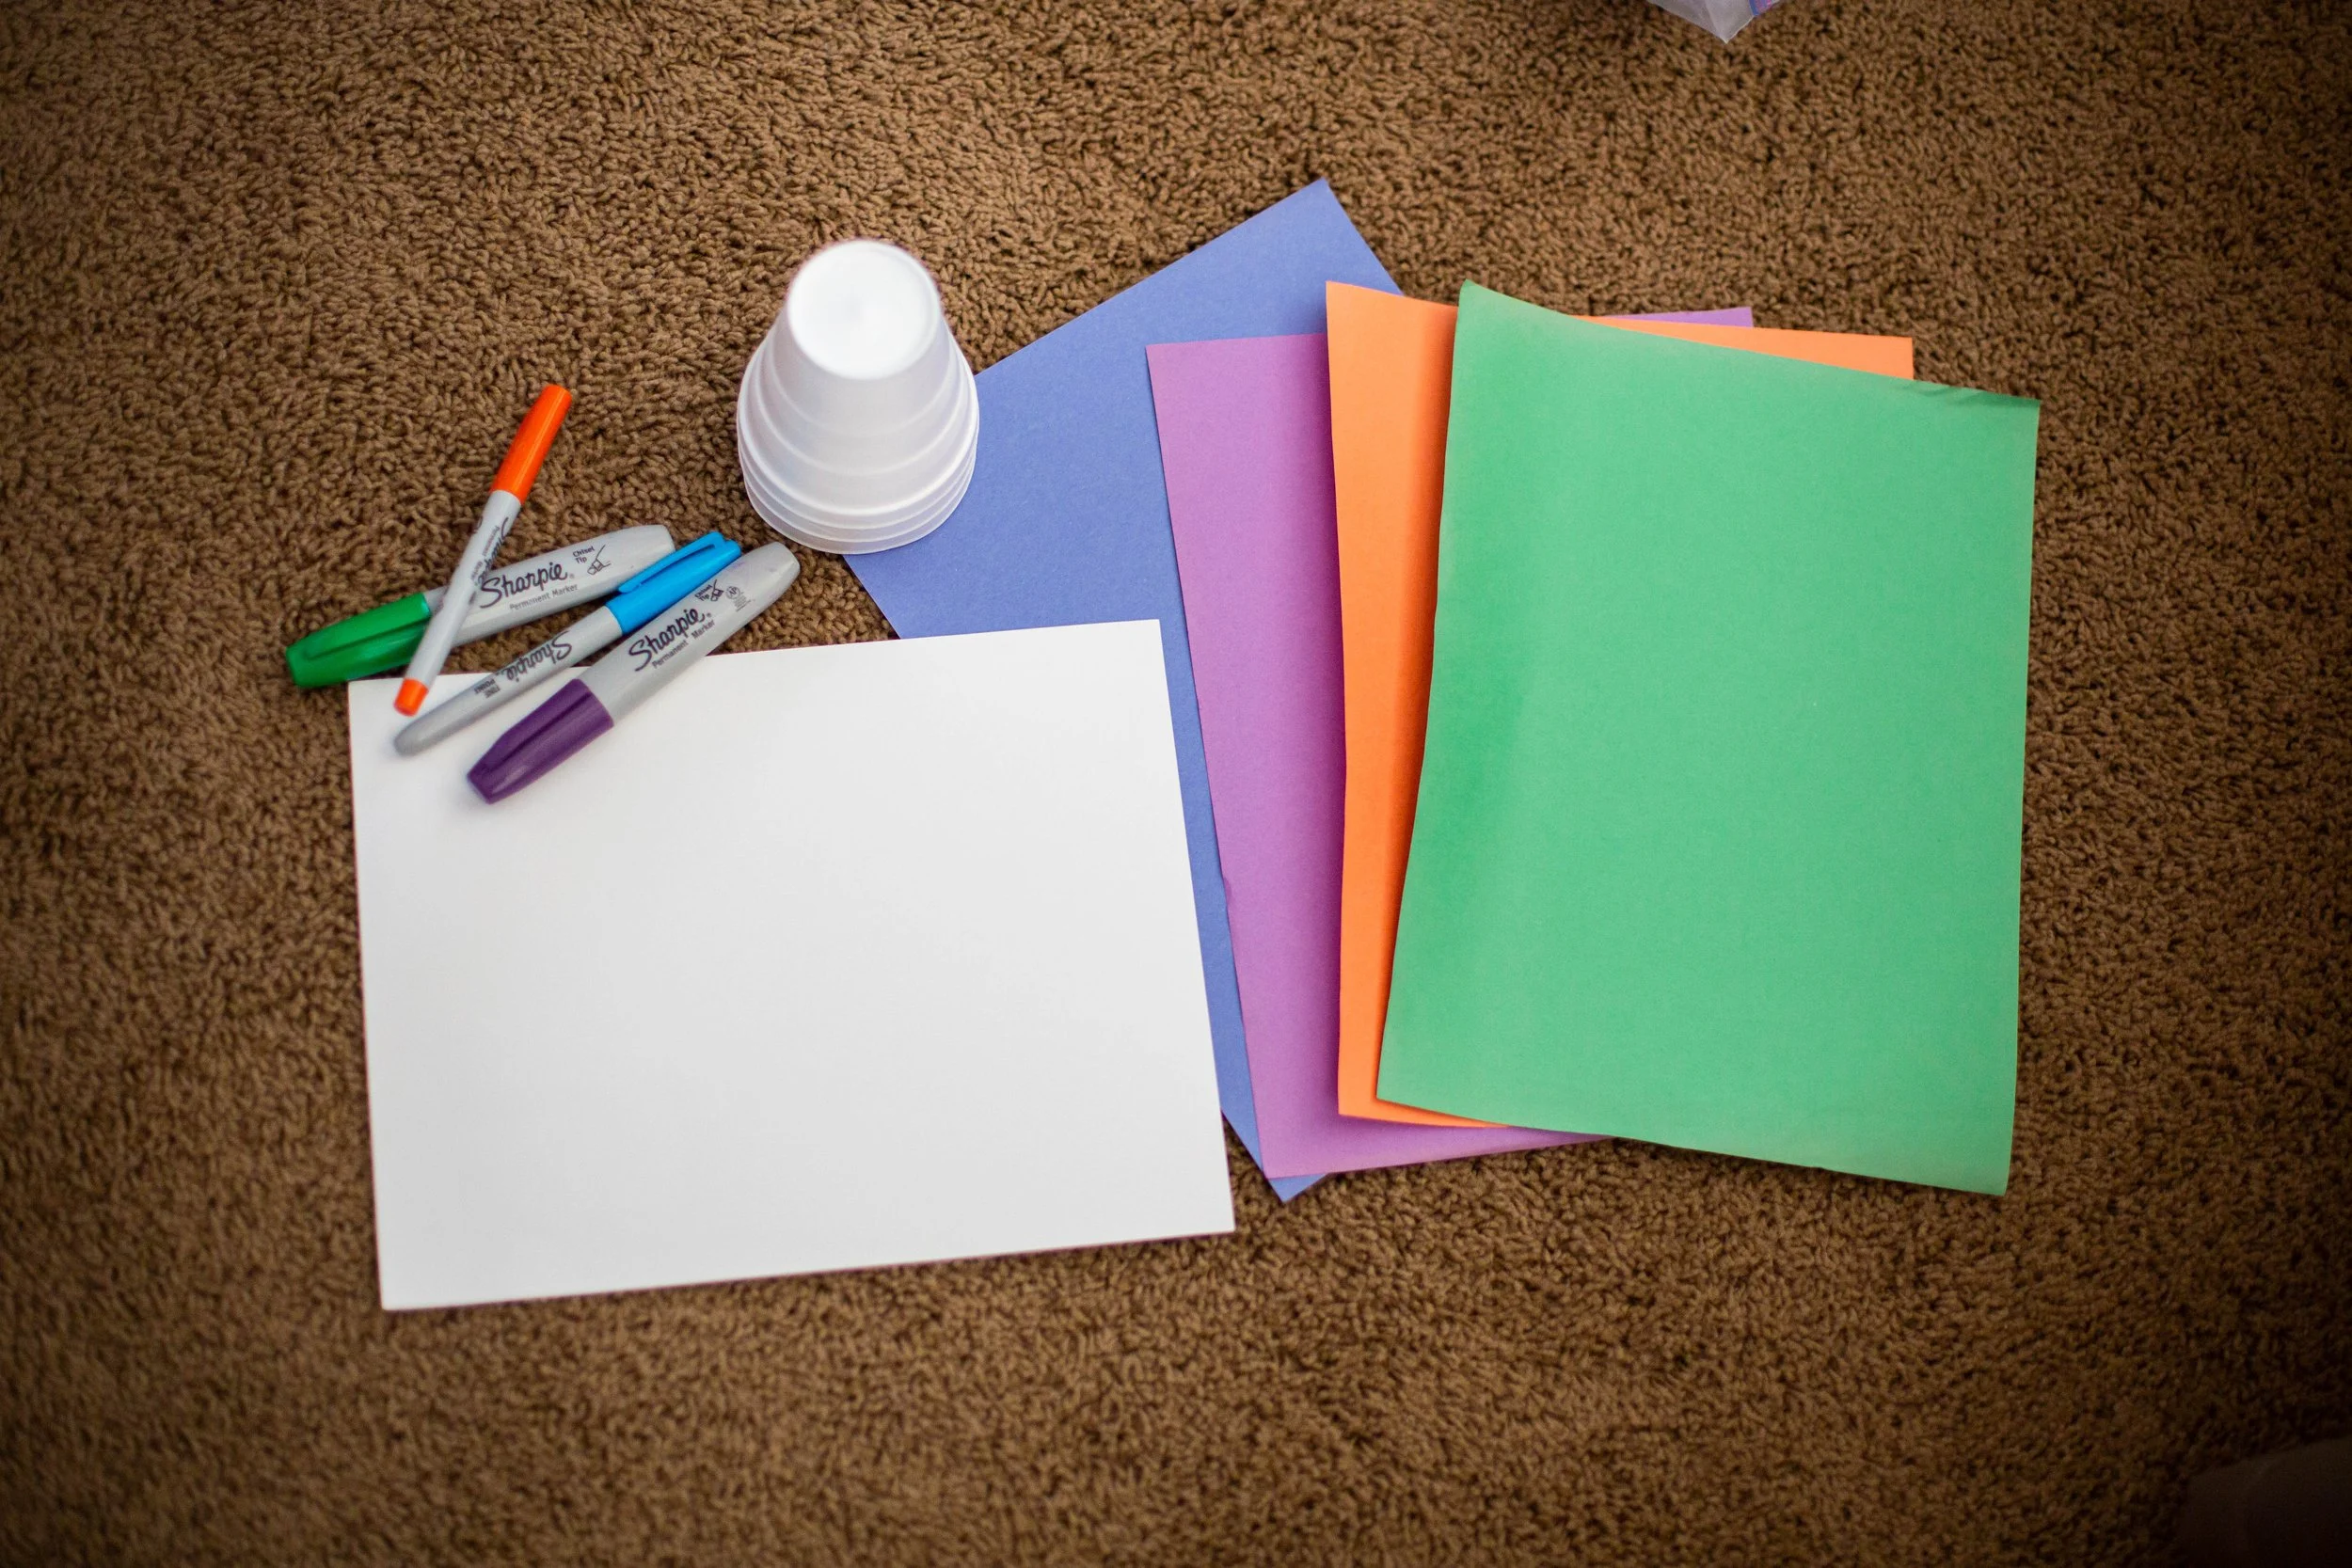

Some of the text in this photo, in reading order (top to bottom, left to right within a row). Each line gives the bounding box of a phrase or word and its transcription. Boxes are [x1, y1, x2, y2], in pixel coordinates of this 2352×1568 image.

[573, 546, 595, 557] Chisel
[576, 556, 588, 564] Tip
[480, 562, 567, 609] Sharpie
[509, 584, 579, 610] Permanent Marker
[700, 593, 710, 601] Tip
[502, 630, 572, 682] Sharpie
[628, 608, 705, 672] Sharpie
[652, 620, 716, 669] Permanent Marker
